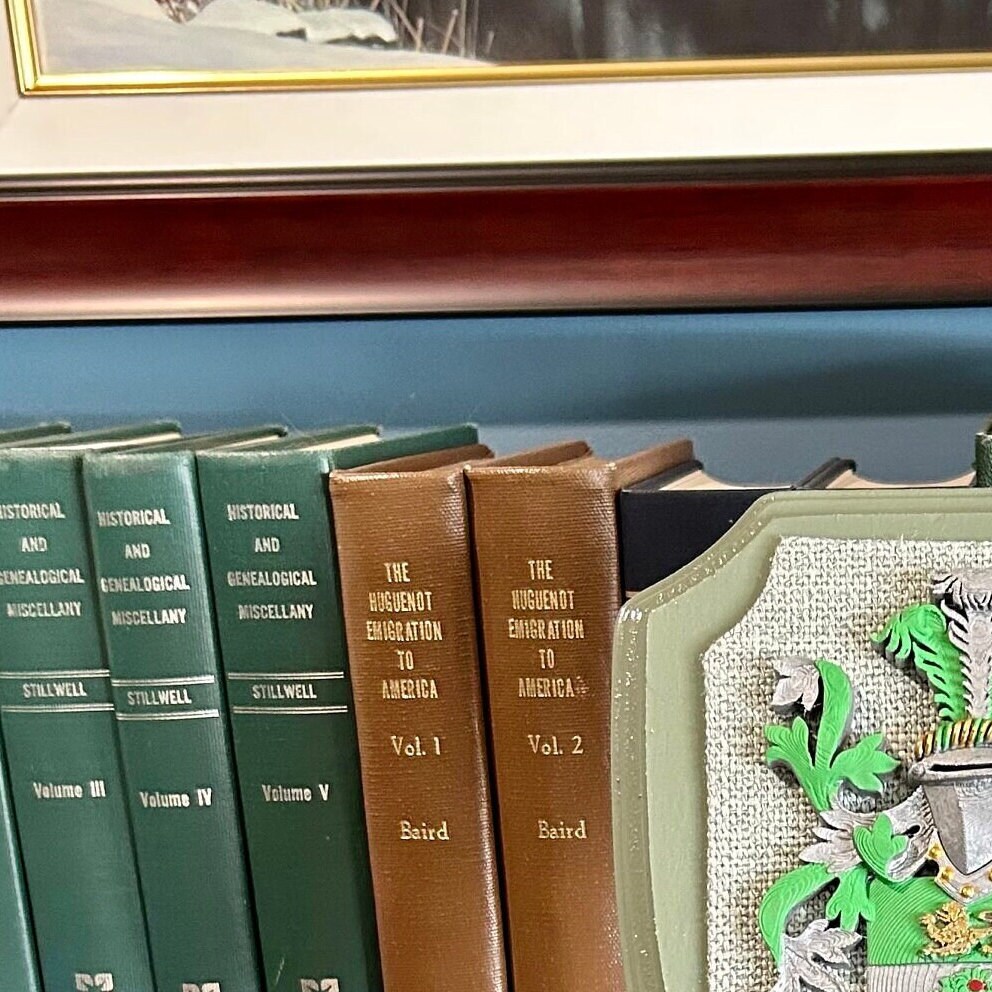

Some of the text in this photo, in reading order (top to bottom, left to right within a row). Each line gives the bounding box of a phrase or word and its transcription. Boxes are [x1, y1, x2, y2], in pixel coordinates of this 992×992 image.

[98, 509, 170, 526] HISTORICAL
[227, 503, 299, 520] HISTORICAL
[21, 536, 48, 552] AND
[125, 544, 150, 559] AND
[254, 537, 280, 552] AND
[227, 571, 317, 586] GENEALOGICAL
[384, 562, 410, 583] THE
[528, 560, 553, 580] THE
[101, 575, 190, 593] GENEALOGICAL
[7, 601, 81, 617] MISCELLANY
[369, 591, 432, 612] HUGUENOT
[512, 590, 574, 610] HUGUENOT
[112, 608, 186, 625] MISCELLANY
[238, 604, 313, 620] MISCELLANY
[366, 621, 442, 641] EMIGRATION
[508, 619, 584, 639] EMIGRATION
[397, 650, 414, 670] TO
[539, 649, 555, 668] TO
[23, 682, 87, 698] STILLWELL
[252, 684, 317, 700] STILLWELL
[382, 679, 438, 699] AMERICA
[518, 678, 575, 697] AMERICA
[127, 689, 192, 706] STILLWELL
[391, 736, 426, 756] Vol.
[528, 734, 583, 756] Vol. 2
[33, 780, 106, 798] Volume III
[139, 788, 212, 808] Volume IV
[261, 784, 330, 802] Volume V
[400, 820, 450, 841] Baird
[538, 820, 587, 840] Baird
